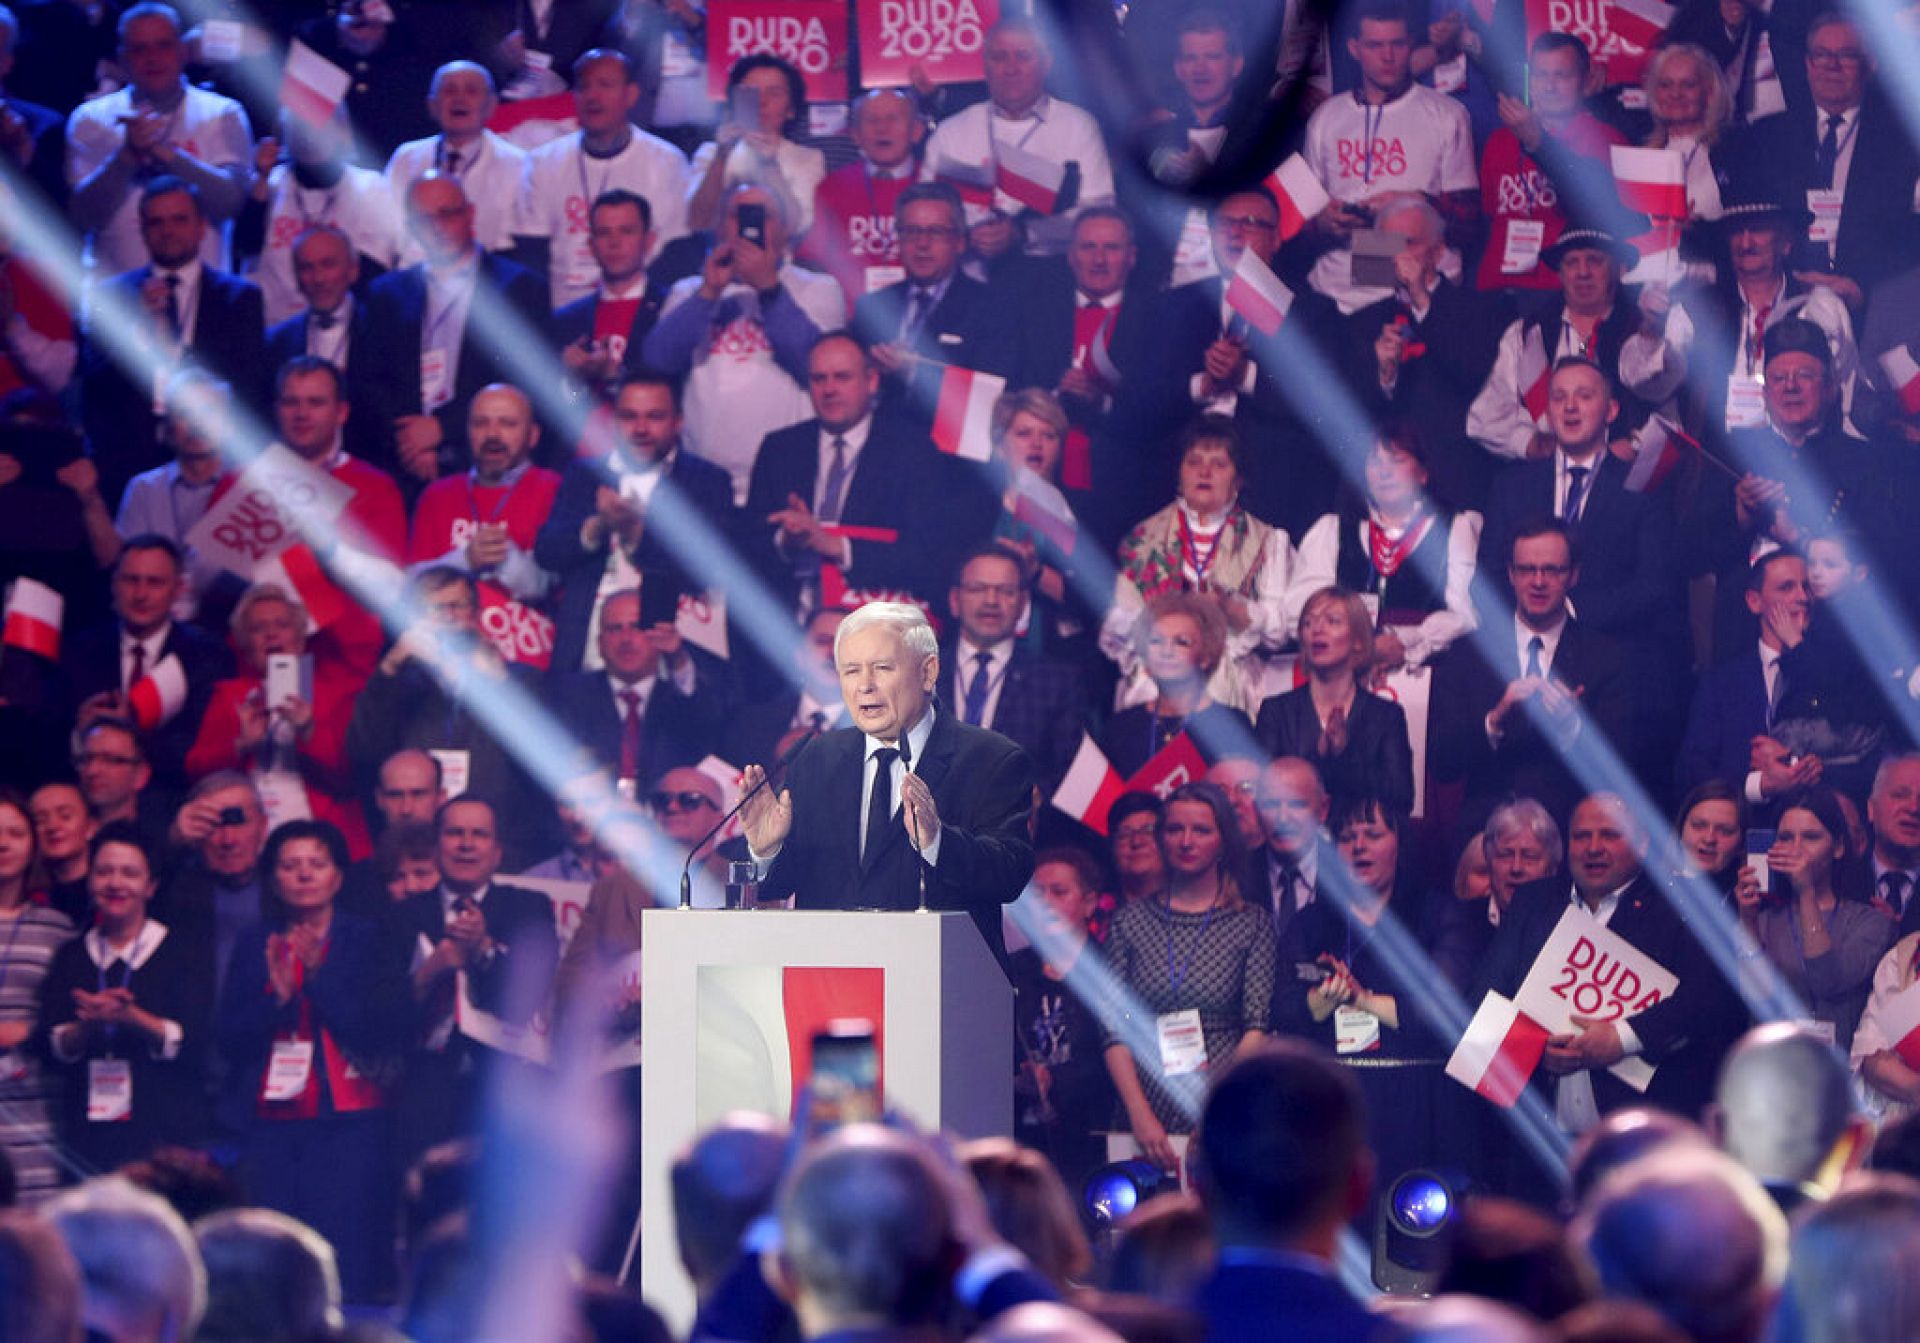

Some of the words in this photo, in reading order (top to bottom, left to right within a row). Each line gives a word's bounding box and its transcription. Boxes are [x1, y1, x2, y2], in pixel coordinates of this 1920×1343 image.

[881, 0, 981, 30] DUDA
[1548, 0, 1613, 37] DU
[729, 16, 829, 48] DUDA
[880, 23, 983, 57] 2020
[1337, 138, 1405, 157] DUDA
[1338, 154, 1408, 178] 2020
[849, 215, 896, 239] DU
[1567, 935, 1661, 1012] DUDA
[1550, 966, 1624, 1022] 202
